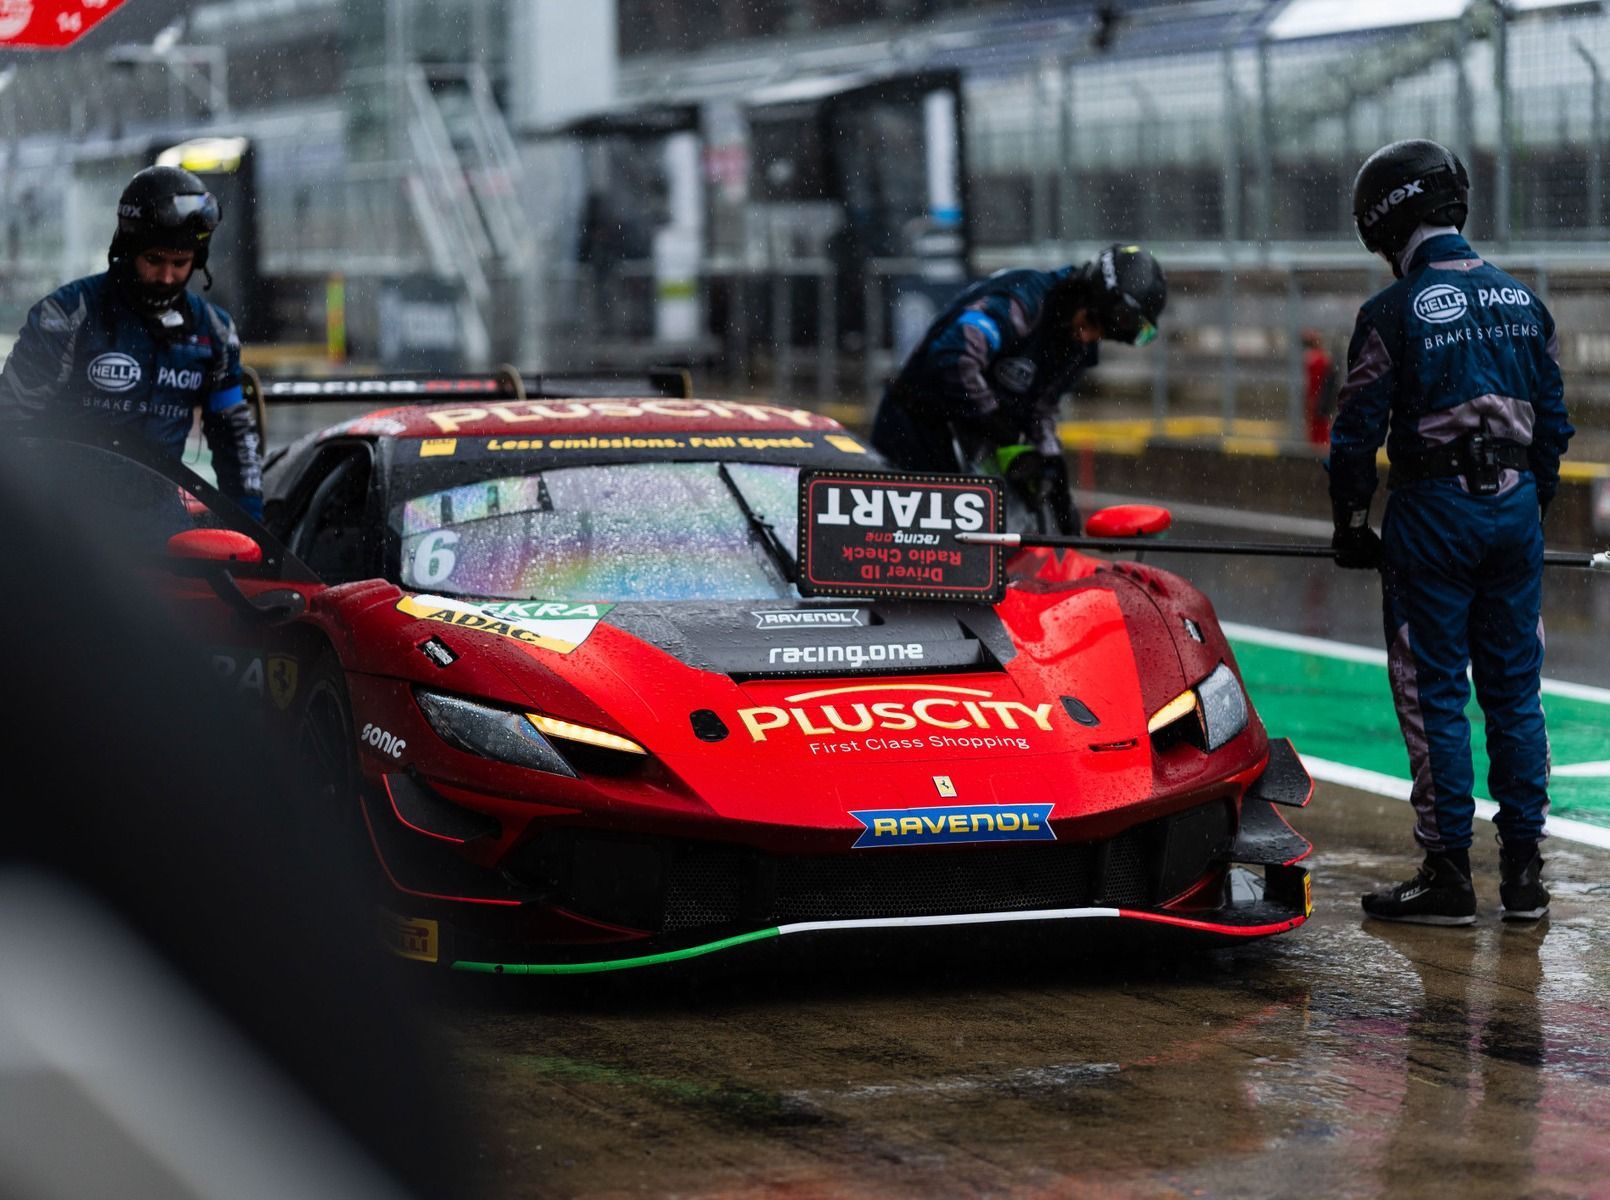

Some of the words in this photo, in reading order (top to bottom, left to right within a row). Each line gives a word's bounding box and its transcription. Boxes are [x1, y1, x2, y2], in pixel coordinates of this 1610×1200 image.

[1362, 179, 1424, 227] uvex
[1418, 291, 1468, 315] HELLA
[1477, 287, 1531, 307] PAGID
[1424, 328, 1472, 350] BRAKE
[1477, 324, 1539, 340] SYSTEMS
[91, 364, 142, 382] HELLA
[157, 365, 202, 390] PAGID
[486, 438, 544, 451] Less
[548, 436, 686, 450] emissions.
[689, 436, 737, 448] Full
[817, 487, 985, 532] START
[413, 529, 460, 586] 6
[841, 546, 902, 563] Check
[908, 549, 962, 566] Radio
[860, 564, 881, 580] ID
[886, 565, 943, 582] Driver
[425, 608, 541, 642] ADAC
[764, 611, 852, 624] RAVENOL
[809, 741, 861, 755] First
[865, 736, 924, 751] Class
[928, 734, 1031, 750] Shopping
[873, 812, 1041, 837] RAVENOL
